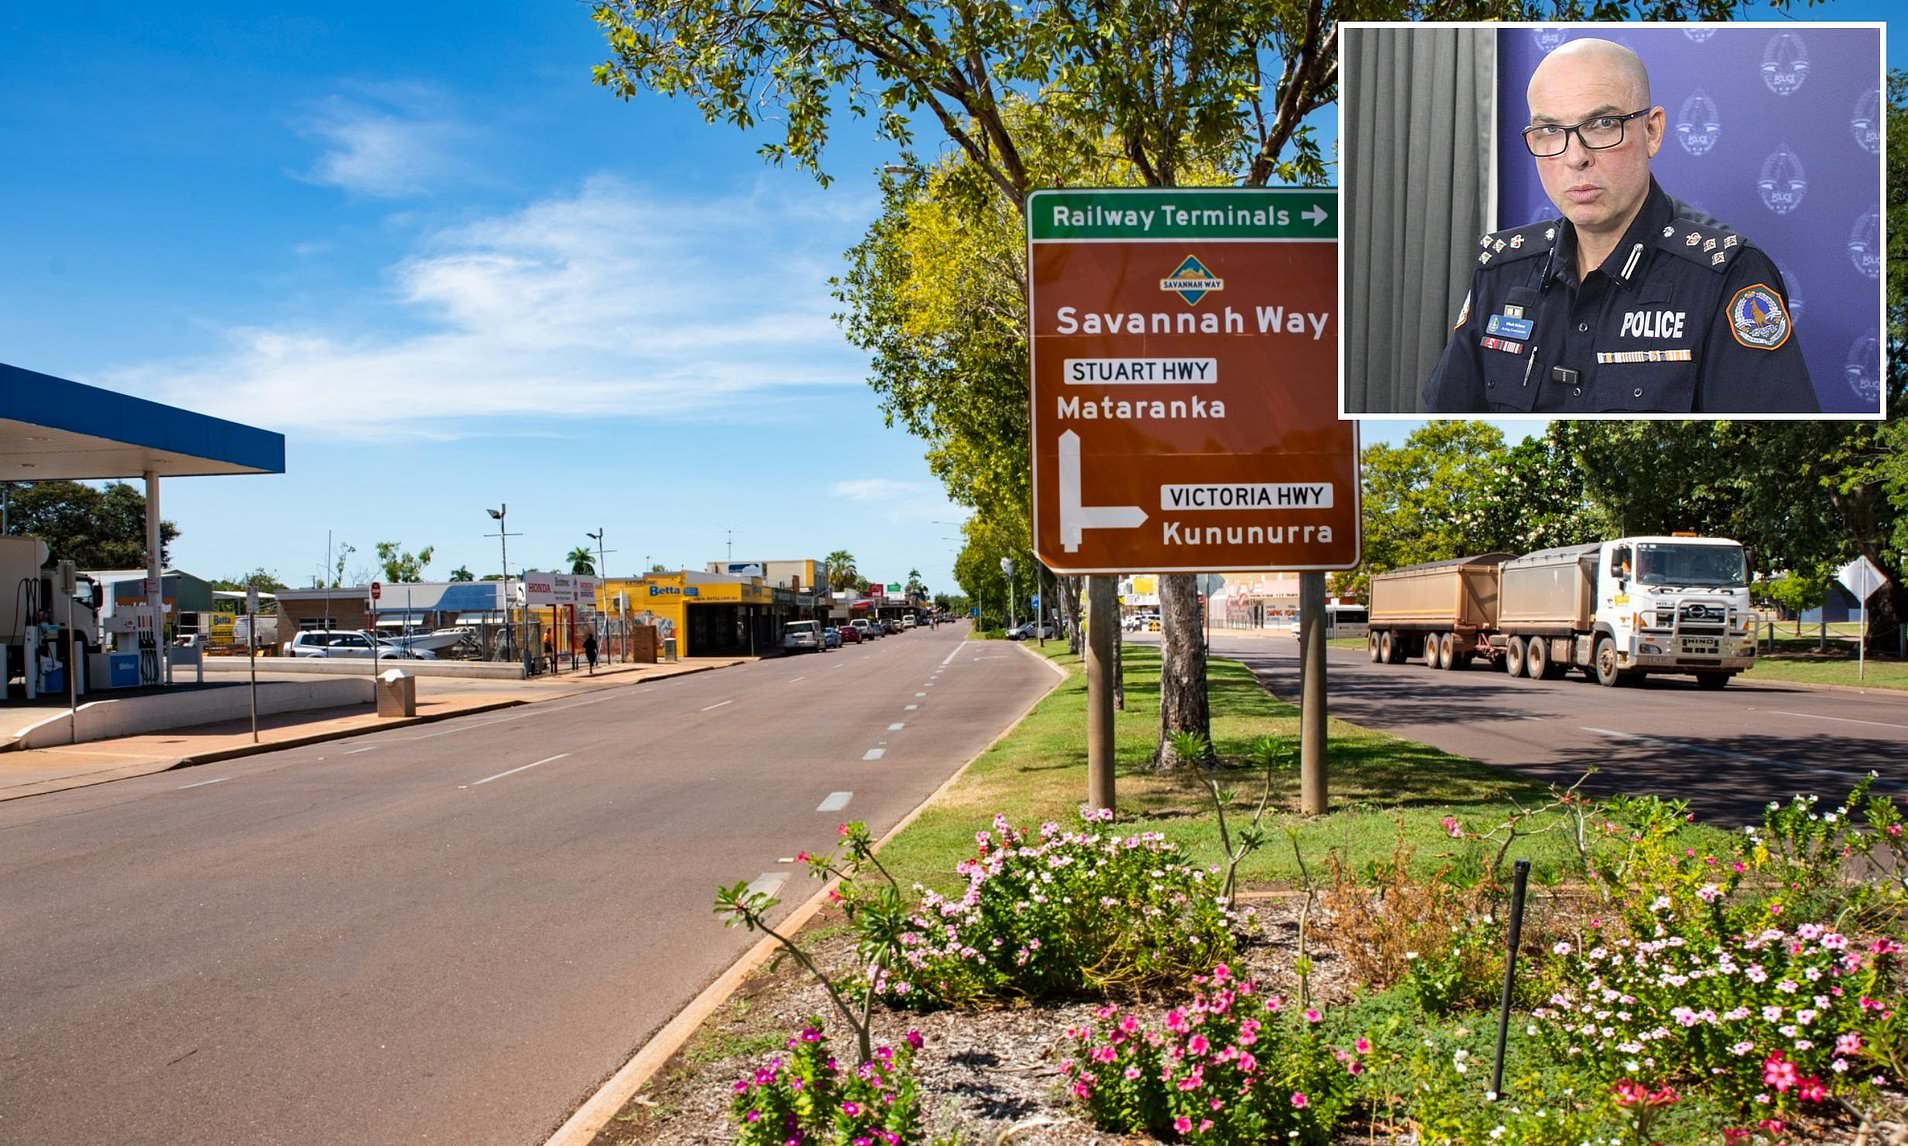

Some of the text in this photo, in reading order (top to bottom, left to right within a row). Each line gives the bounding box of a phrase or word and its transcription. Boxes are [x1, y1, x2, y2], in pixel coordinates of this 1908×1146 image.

[1053, 205, 1290, 231] Railway Terminals
[1163, 281, 1221, 289] SAVANNAH WAY
[1056, 306, 1328, 341] Savannah Way
[1620, 310, 1685, 338] POLICE
[1072, 361, 1210, 381] STUART HWY
[1057, 395, 1225, 419] Mataranka
[1170, 486, 1324, 507] VICTORIA HWY
[1163, 521, 1333, 545] Kununurra
[528, 583, 552, 593] HONDA
[649, 585, 681, 597] Betta
